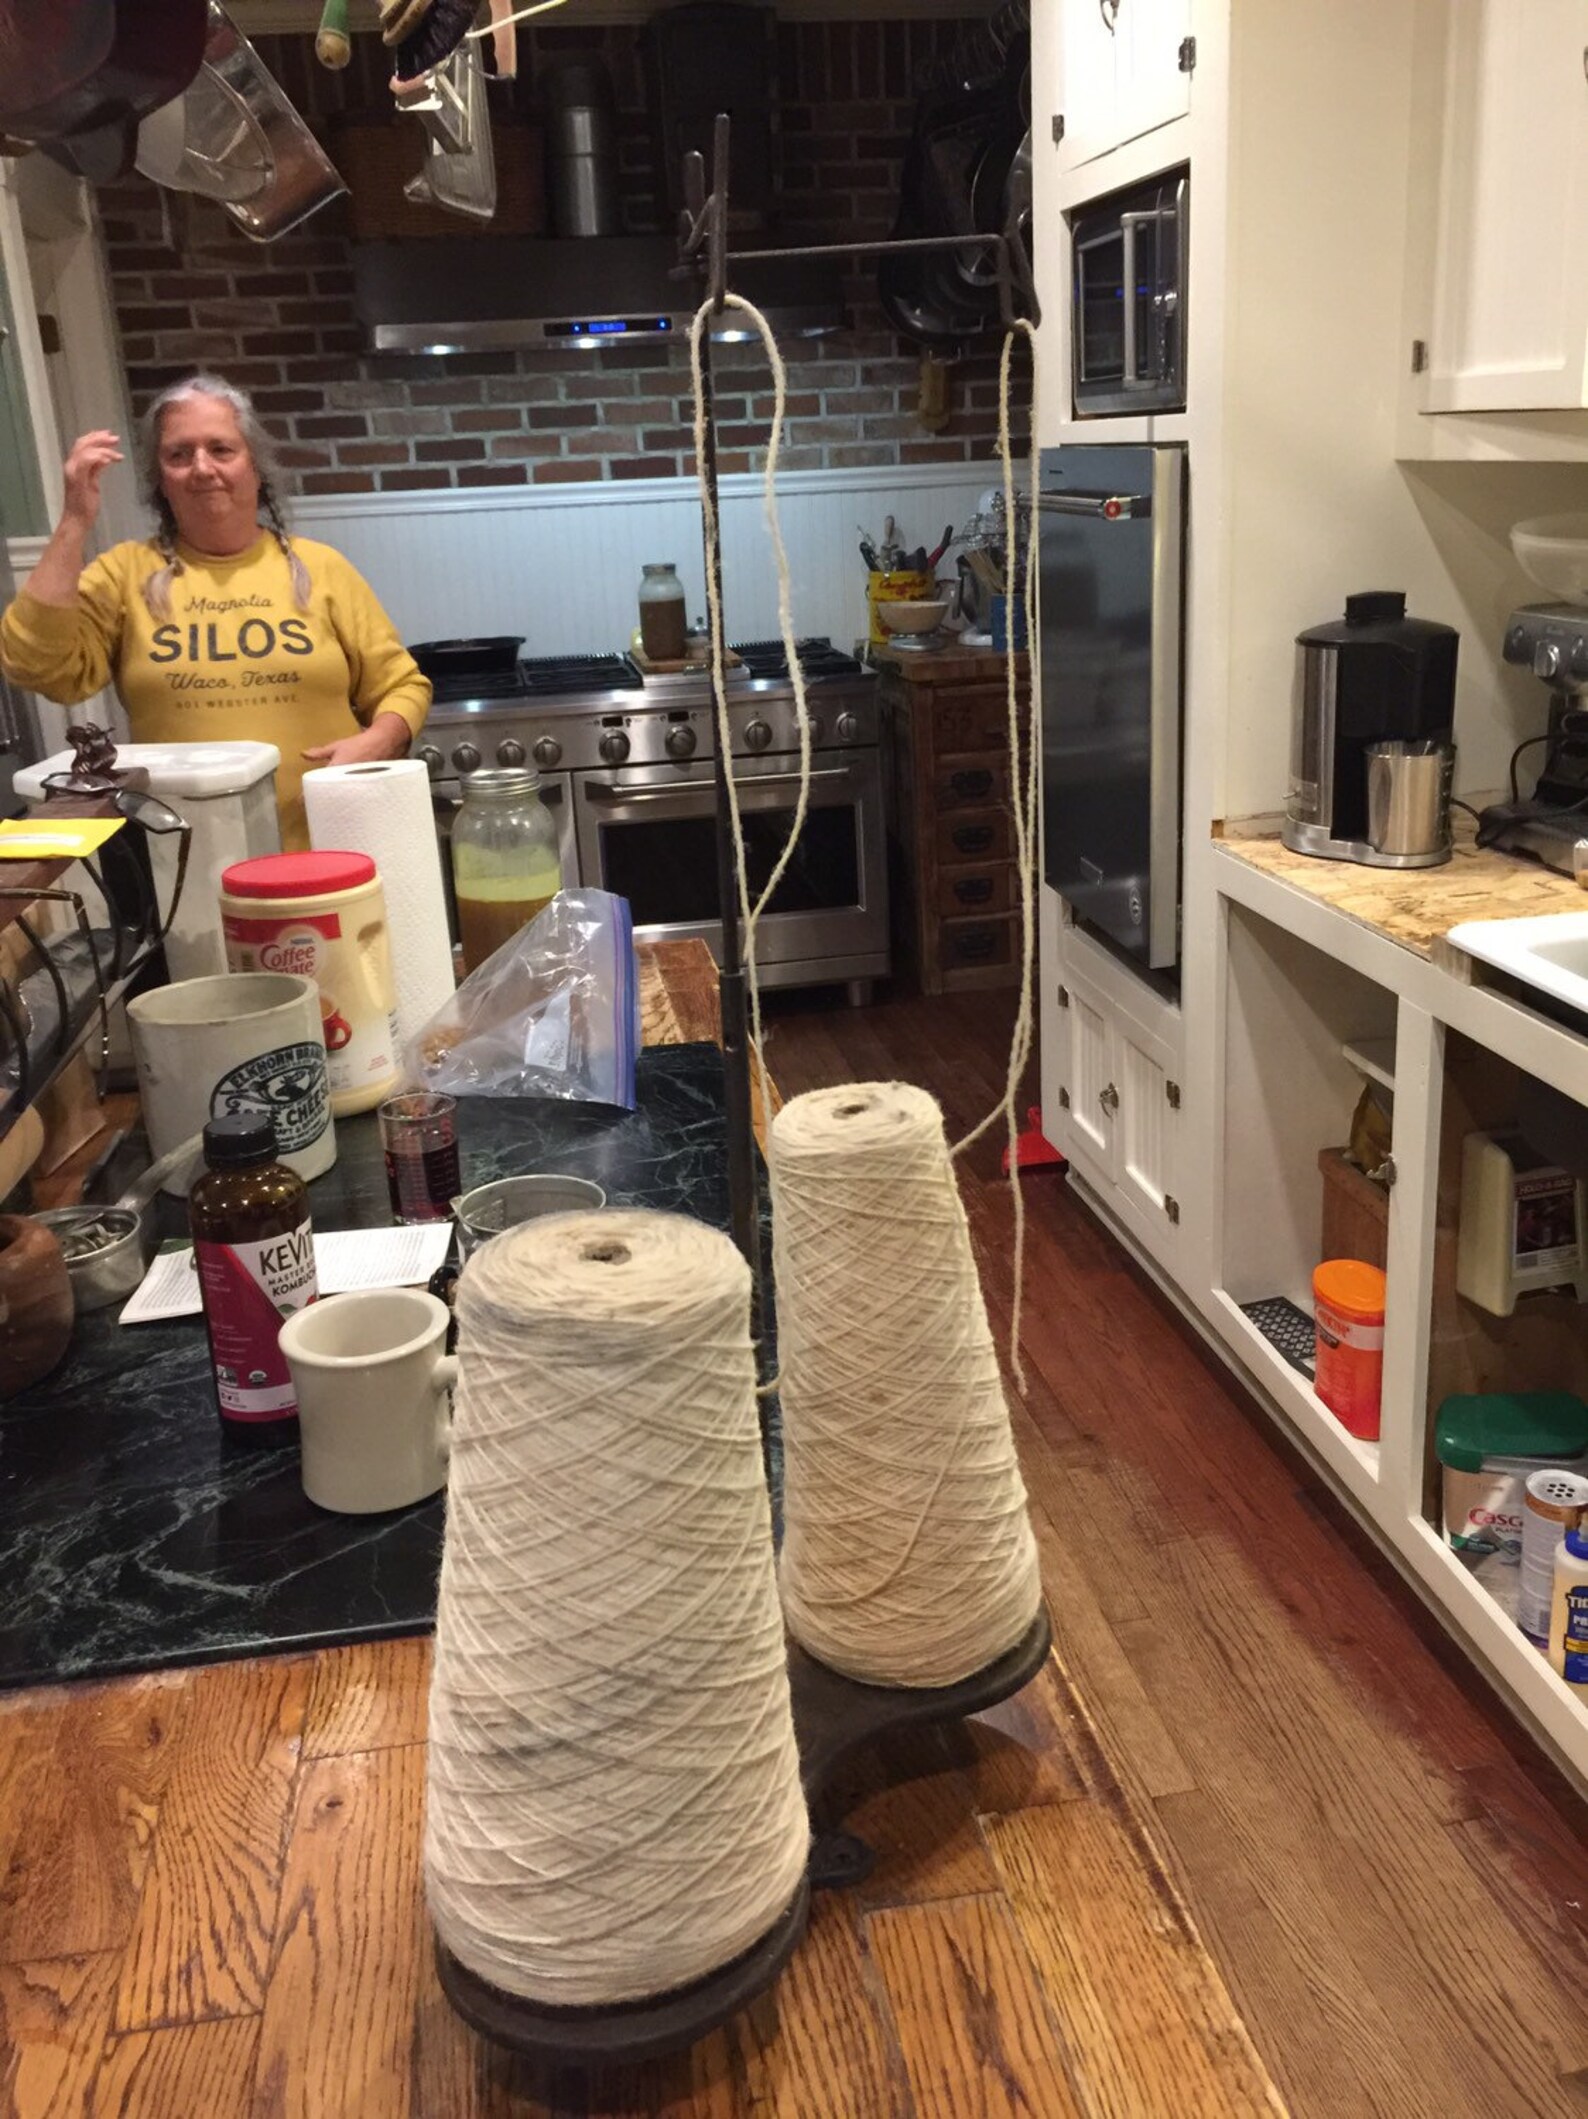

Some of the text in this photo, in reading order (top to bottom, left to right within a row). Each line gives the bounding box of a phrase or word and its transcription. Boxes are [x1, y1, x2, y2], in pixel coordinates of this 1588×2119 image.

[184, 594, 273, 614] Magnolia
[148, 618, 314, 663] SILOS
[165, 670, 301, 690] Waco, Texas
[260, 944, 315, 971] Coffee
[228, 1051, 294, 1089] ELKHORN
[1468, 1507, 1523, 1527] Casc
